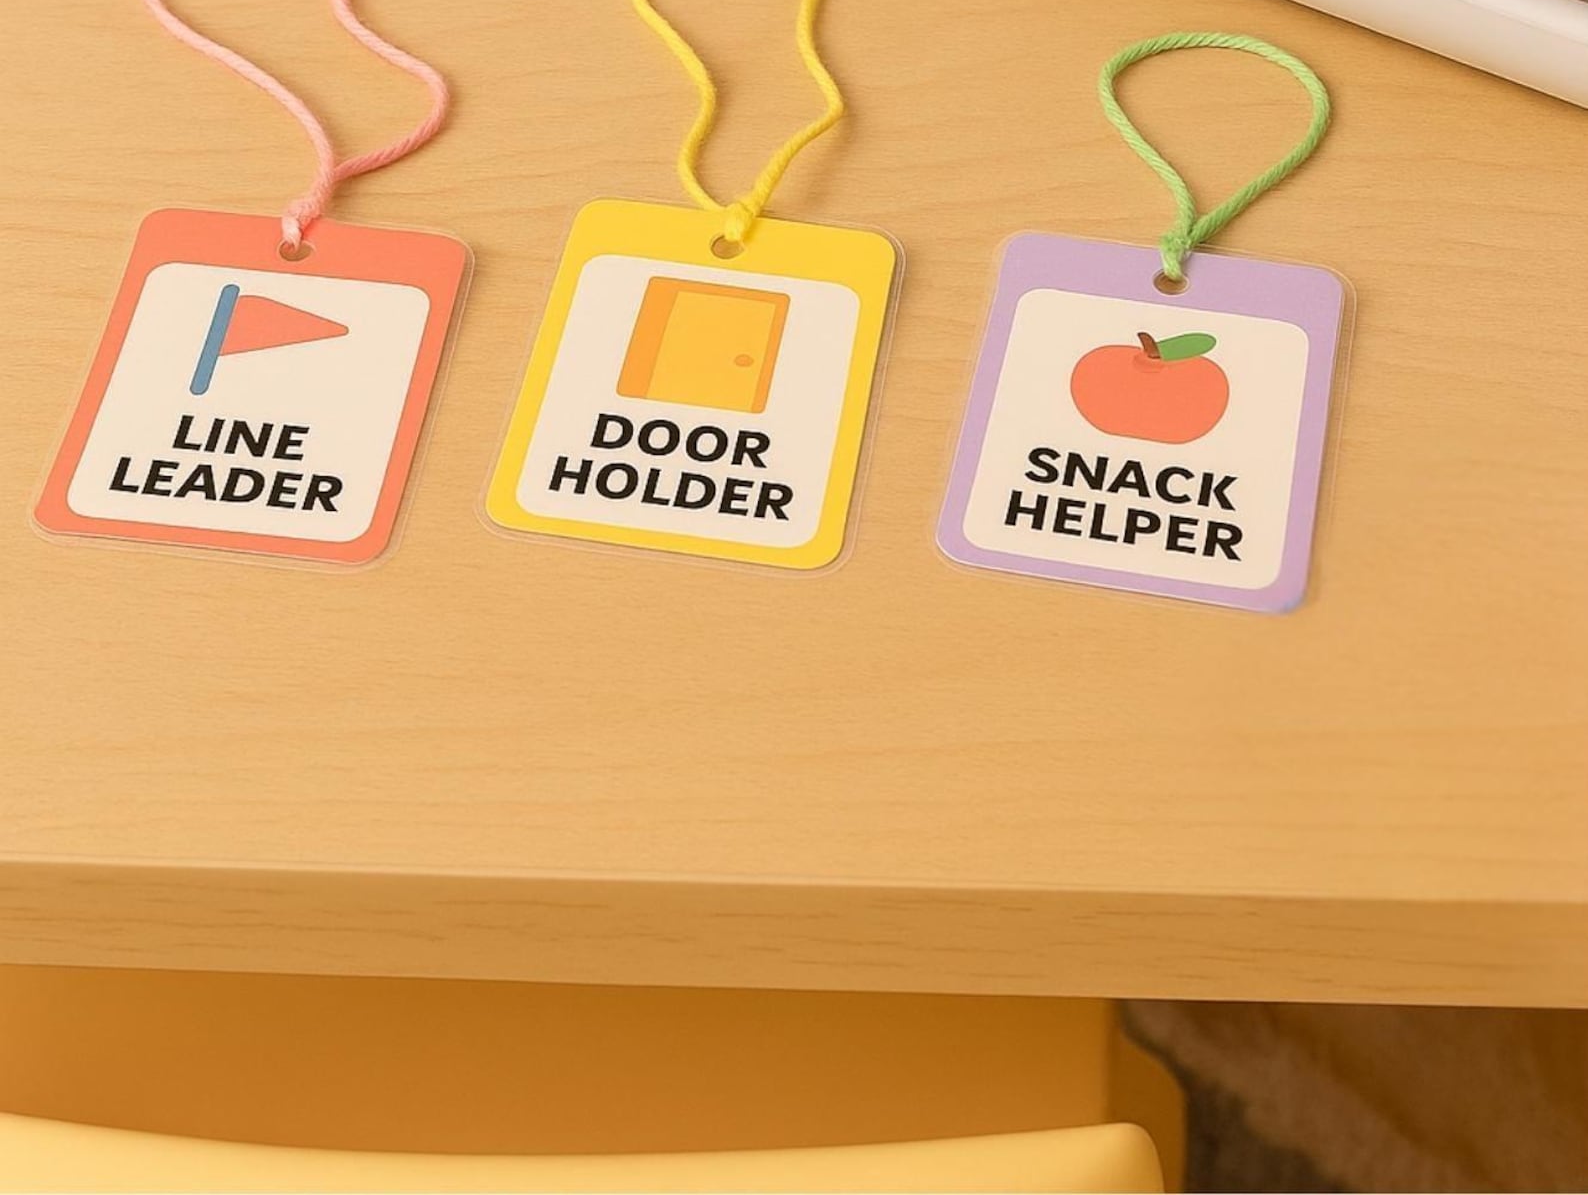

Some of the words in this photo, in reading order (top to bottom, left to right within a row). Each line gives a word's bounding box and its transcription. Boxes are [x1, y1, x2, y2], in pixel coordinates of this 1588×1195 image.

[171, 415, 311, 461] LINE
[590, 412, 772, 469] DOOR
[108, 455, 344, 513] LEADER
[547, 455, 795, 522] HOLDER
[1024, 446, 1238, 512] SNACK
[1004, 489, 1244, 562] HELPER
